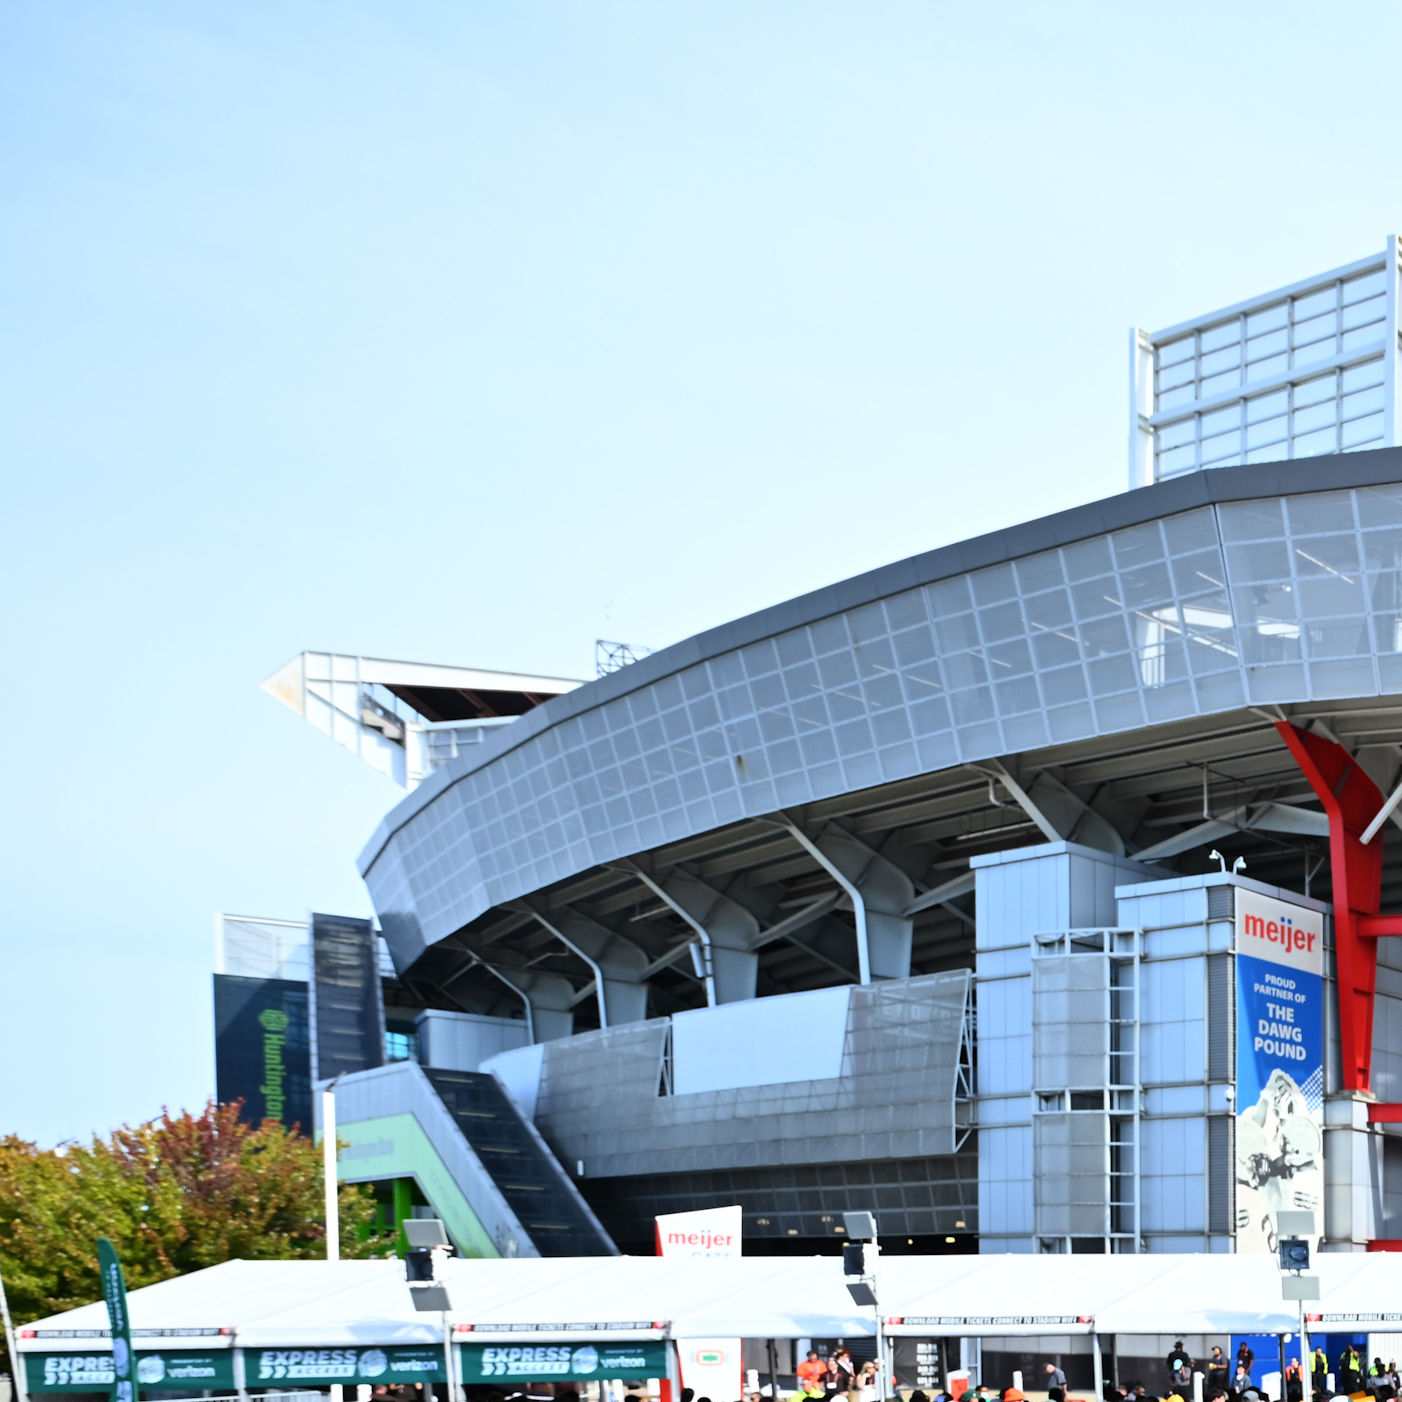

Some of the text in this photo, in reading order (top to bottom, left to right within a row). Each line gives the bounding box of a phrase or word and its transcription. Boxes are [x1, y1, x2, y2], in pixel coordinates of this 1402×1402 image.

[1244, 912, 1315, 953] meijer
[1265, 973, 1296, 990] PROUD
[1254, 983, 1306, 1004] PARTNER OF
[1266, 1002, 1295, 1023] THE
[1258, 1019, 1303, 1042] DAWG
[1254, 1037, 1306, 1061] POUND
[668, 1230, 733, 1249] meijer
[259, 1350, 358, 1365] EXPRESS
[481, 1347, 571, 1362] EXPRESS
[601, 1356, 646, 1368] verizon
[389, 1359, 439, 1371] verizon
